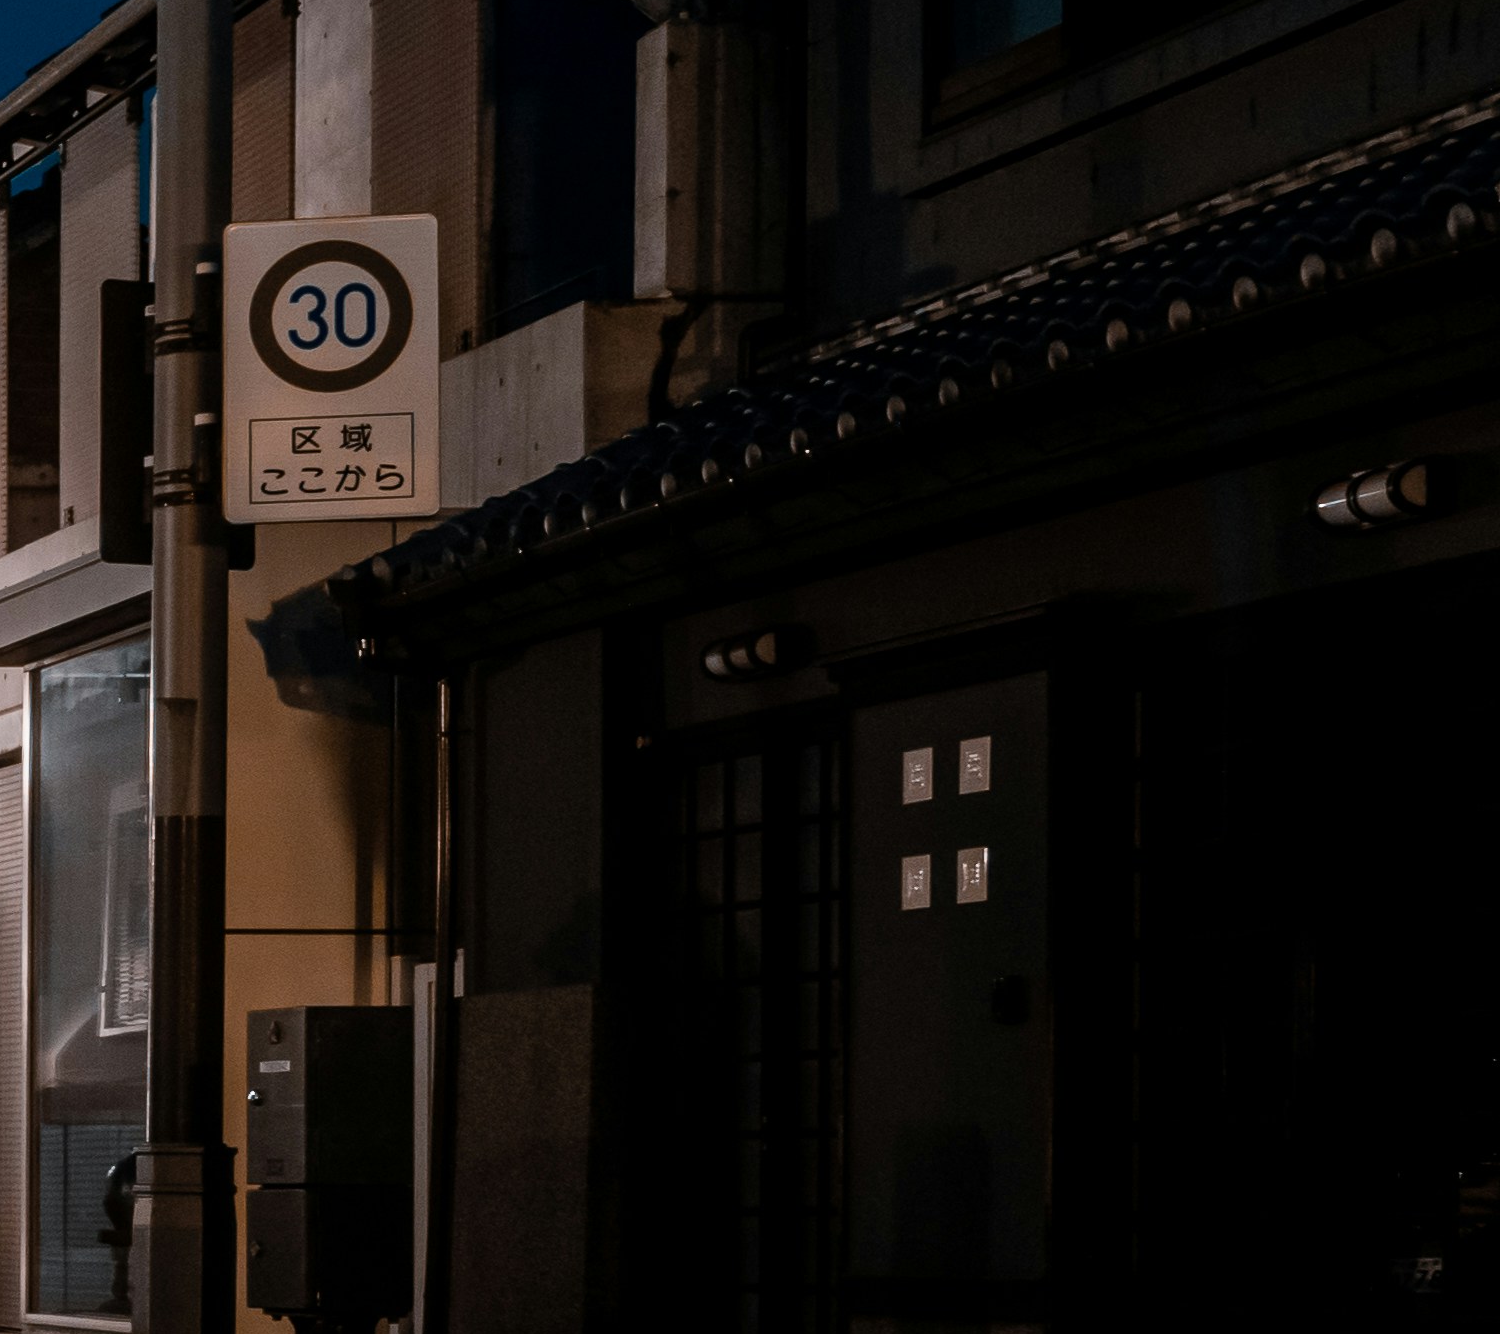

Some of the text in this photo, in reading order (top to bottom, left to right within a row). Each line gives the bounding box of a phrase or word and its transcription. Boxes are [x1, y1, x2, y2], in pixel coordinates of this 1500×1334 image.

[287, 282, 376, 351] 30
[291, 423, 373, 454] 区域
[260, 463, 405, 496] ここから
